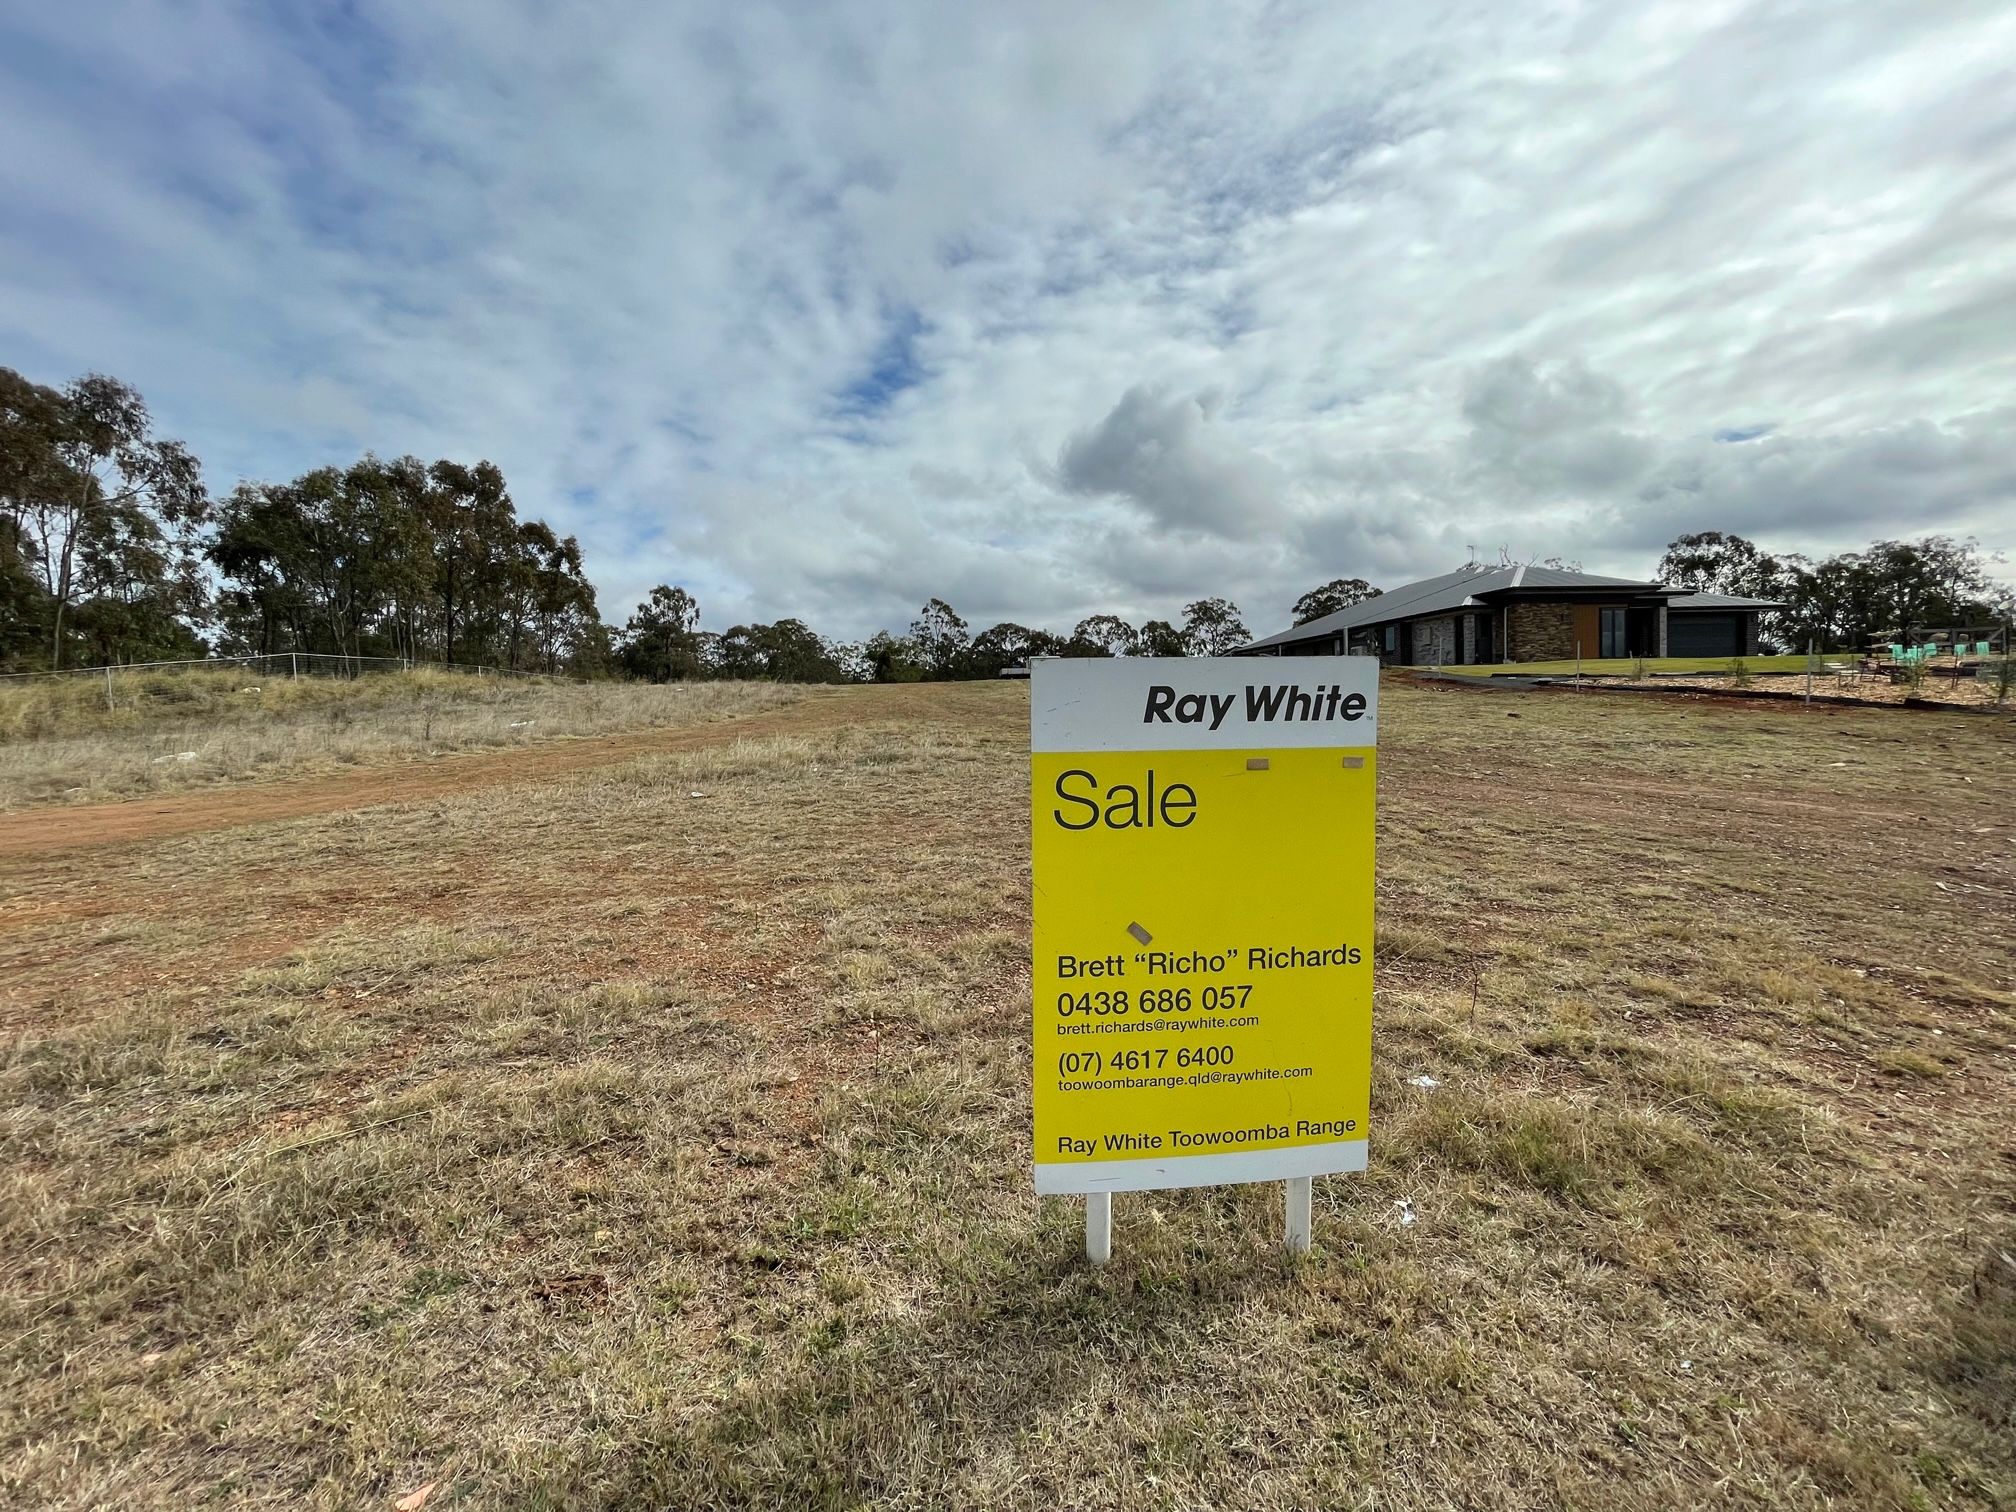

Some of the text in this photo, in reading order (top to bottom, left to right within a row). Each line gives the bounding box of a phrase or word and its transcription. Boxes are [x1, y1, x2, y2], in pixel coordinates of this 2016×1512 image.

[1143, 685, 1367, 730] Ray White
[1053, 769, 1197, 830] Sale
[1058, 944, 1362, 978] Brett “Richo” Richards
[1057, 985, 1253, 1017] 0438 686 057
[1057, 1015, 1259, 1035] brett.richards@raywhite.com
[1058, 1045, 1234, 1077] (07) 4617 6400
[1058, 1065, 1313, 1091] toowoombarange.qld@raywhite.com
[1058, 1118, 1356, 1156] Ray White Toowoomba Range
